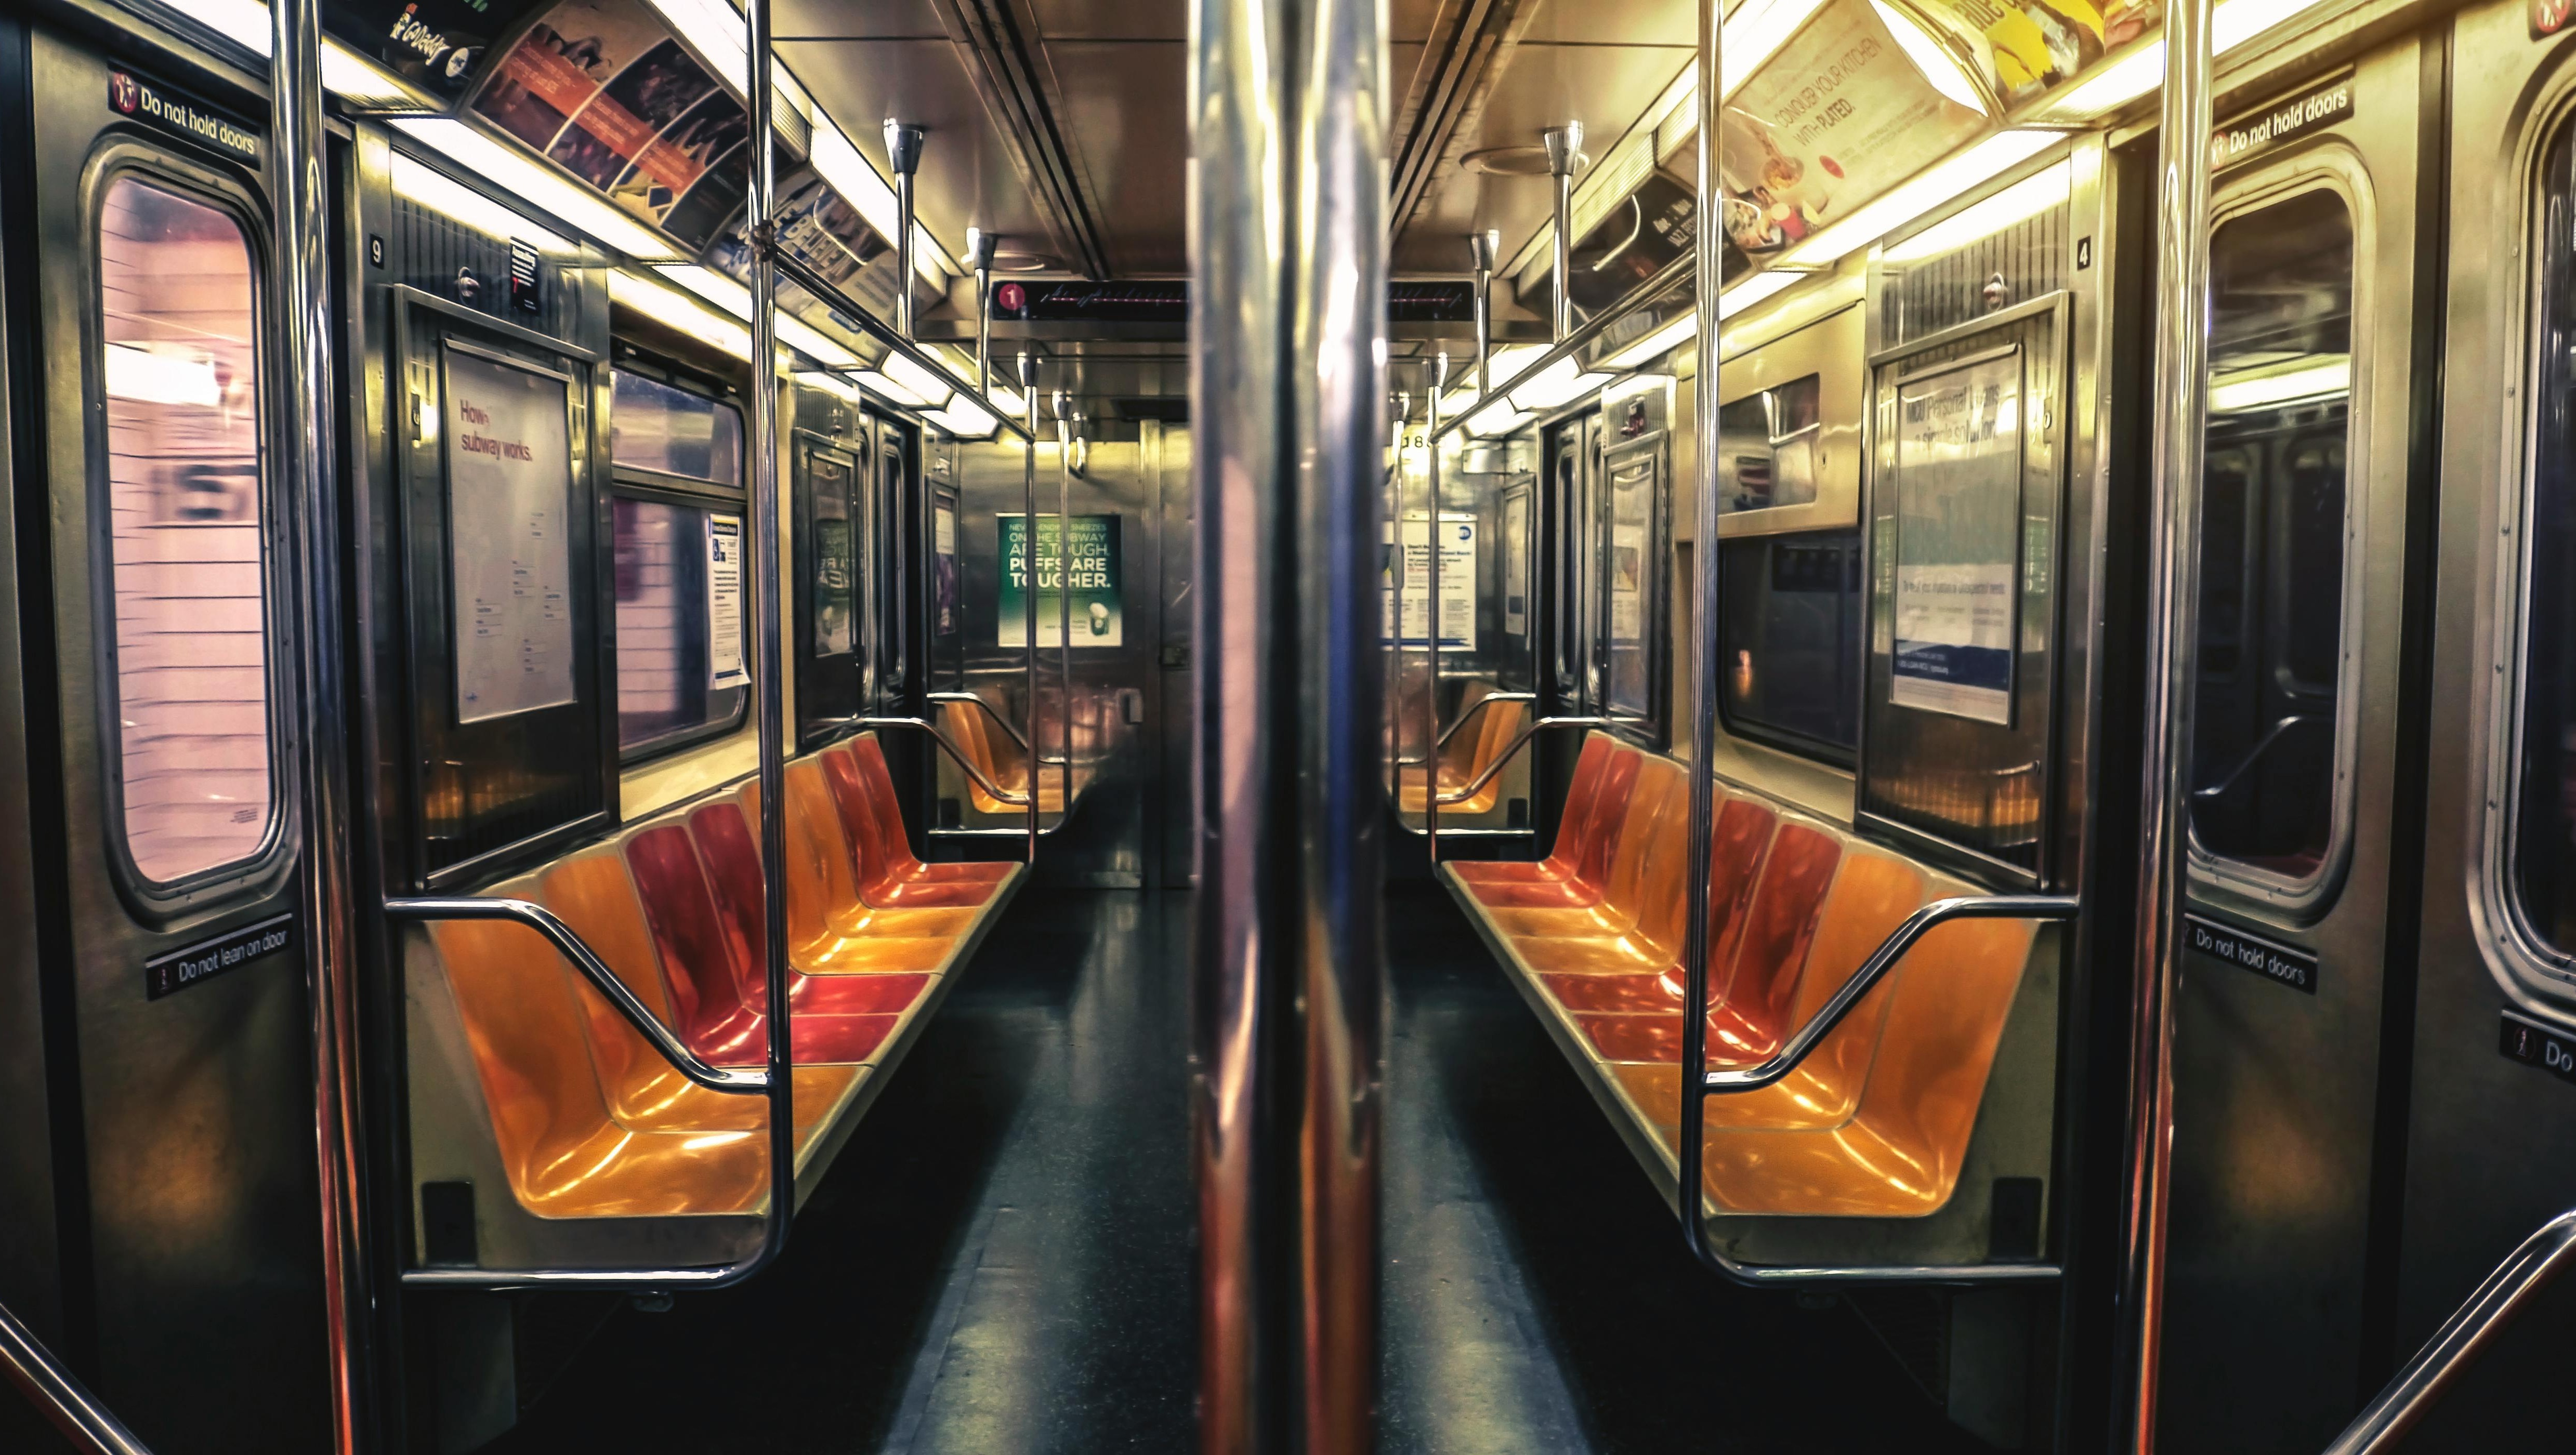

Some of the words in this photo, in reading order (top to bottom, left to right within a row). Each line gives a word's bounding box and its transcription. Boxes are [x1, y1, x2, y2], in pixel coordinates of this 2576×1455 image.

[1774, 86, 1819, 128] CONQUER
[1813, 65, 1842, 96] YOUR
[1838, 36, 1883, 77] KITCHEN
[141, 87, 161, 115] Do
[164, 102, 187, 127] not
[189, 108, 217, 139] hold
[219, 123, 255, 155] doors
[1793, 123, 1823, 147] WITH
[1816, 98, 1856, 131] PLATED.
[2230, 130, 2248, 154] Do
[2250, 117, 2272, 146] not
[2273, 101, 2304, 136] hold
[2305, 88, 2348, 122] doors
[372, 240, 381, 263] 9
[2079, 242, 2088, 266] 4
[1006, 289, 1014, 303] 1
[461, 430, 500, 461] subway
[502, 439, 533, 462] works.
[1009, 532, 1028, 543] ON
[1036, 532, 1051, 543] HE
[1070, 557, 1107, 571] ARE
[179, 961, 196, 983] Do
[199, 951, 219, 975] not
[220, 947, 245, 967] lean
[247, 940, 260, 956] on
[262, 931, 286, 951] door
[2197, 929, 2212, 949] Do
[2215, 940, 2234, 959] not
[2238, 943, 2265, 970] hold
[2268, 956, 2305, 986] doors
[2545, 1040, 2573, 1073] Do
